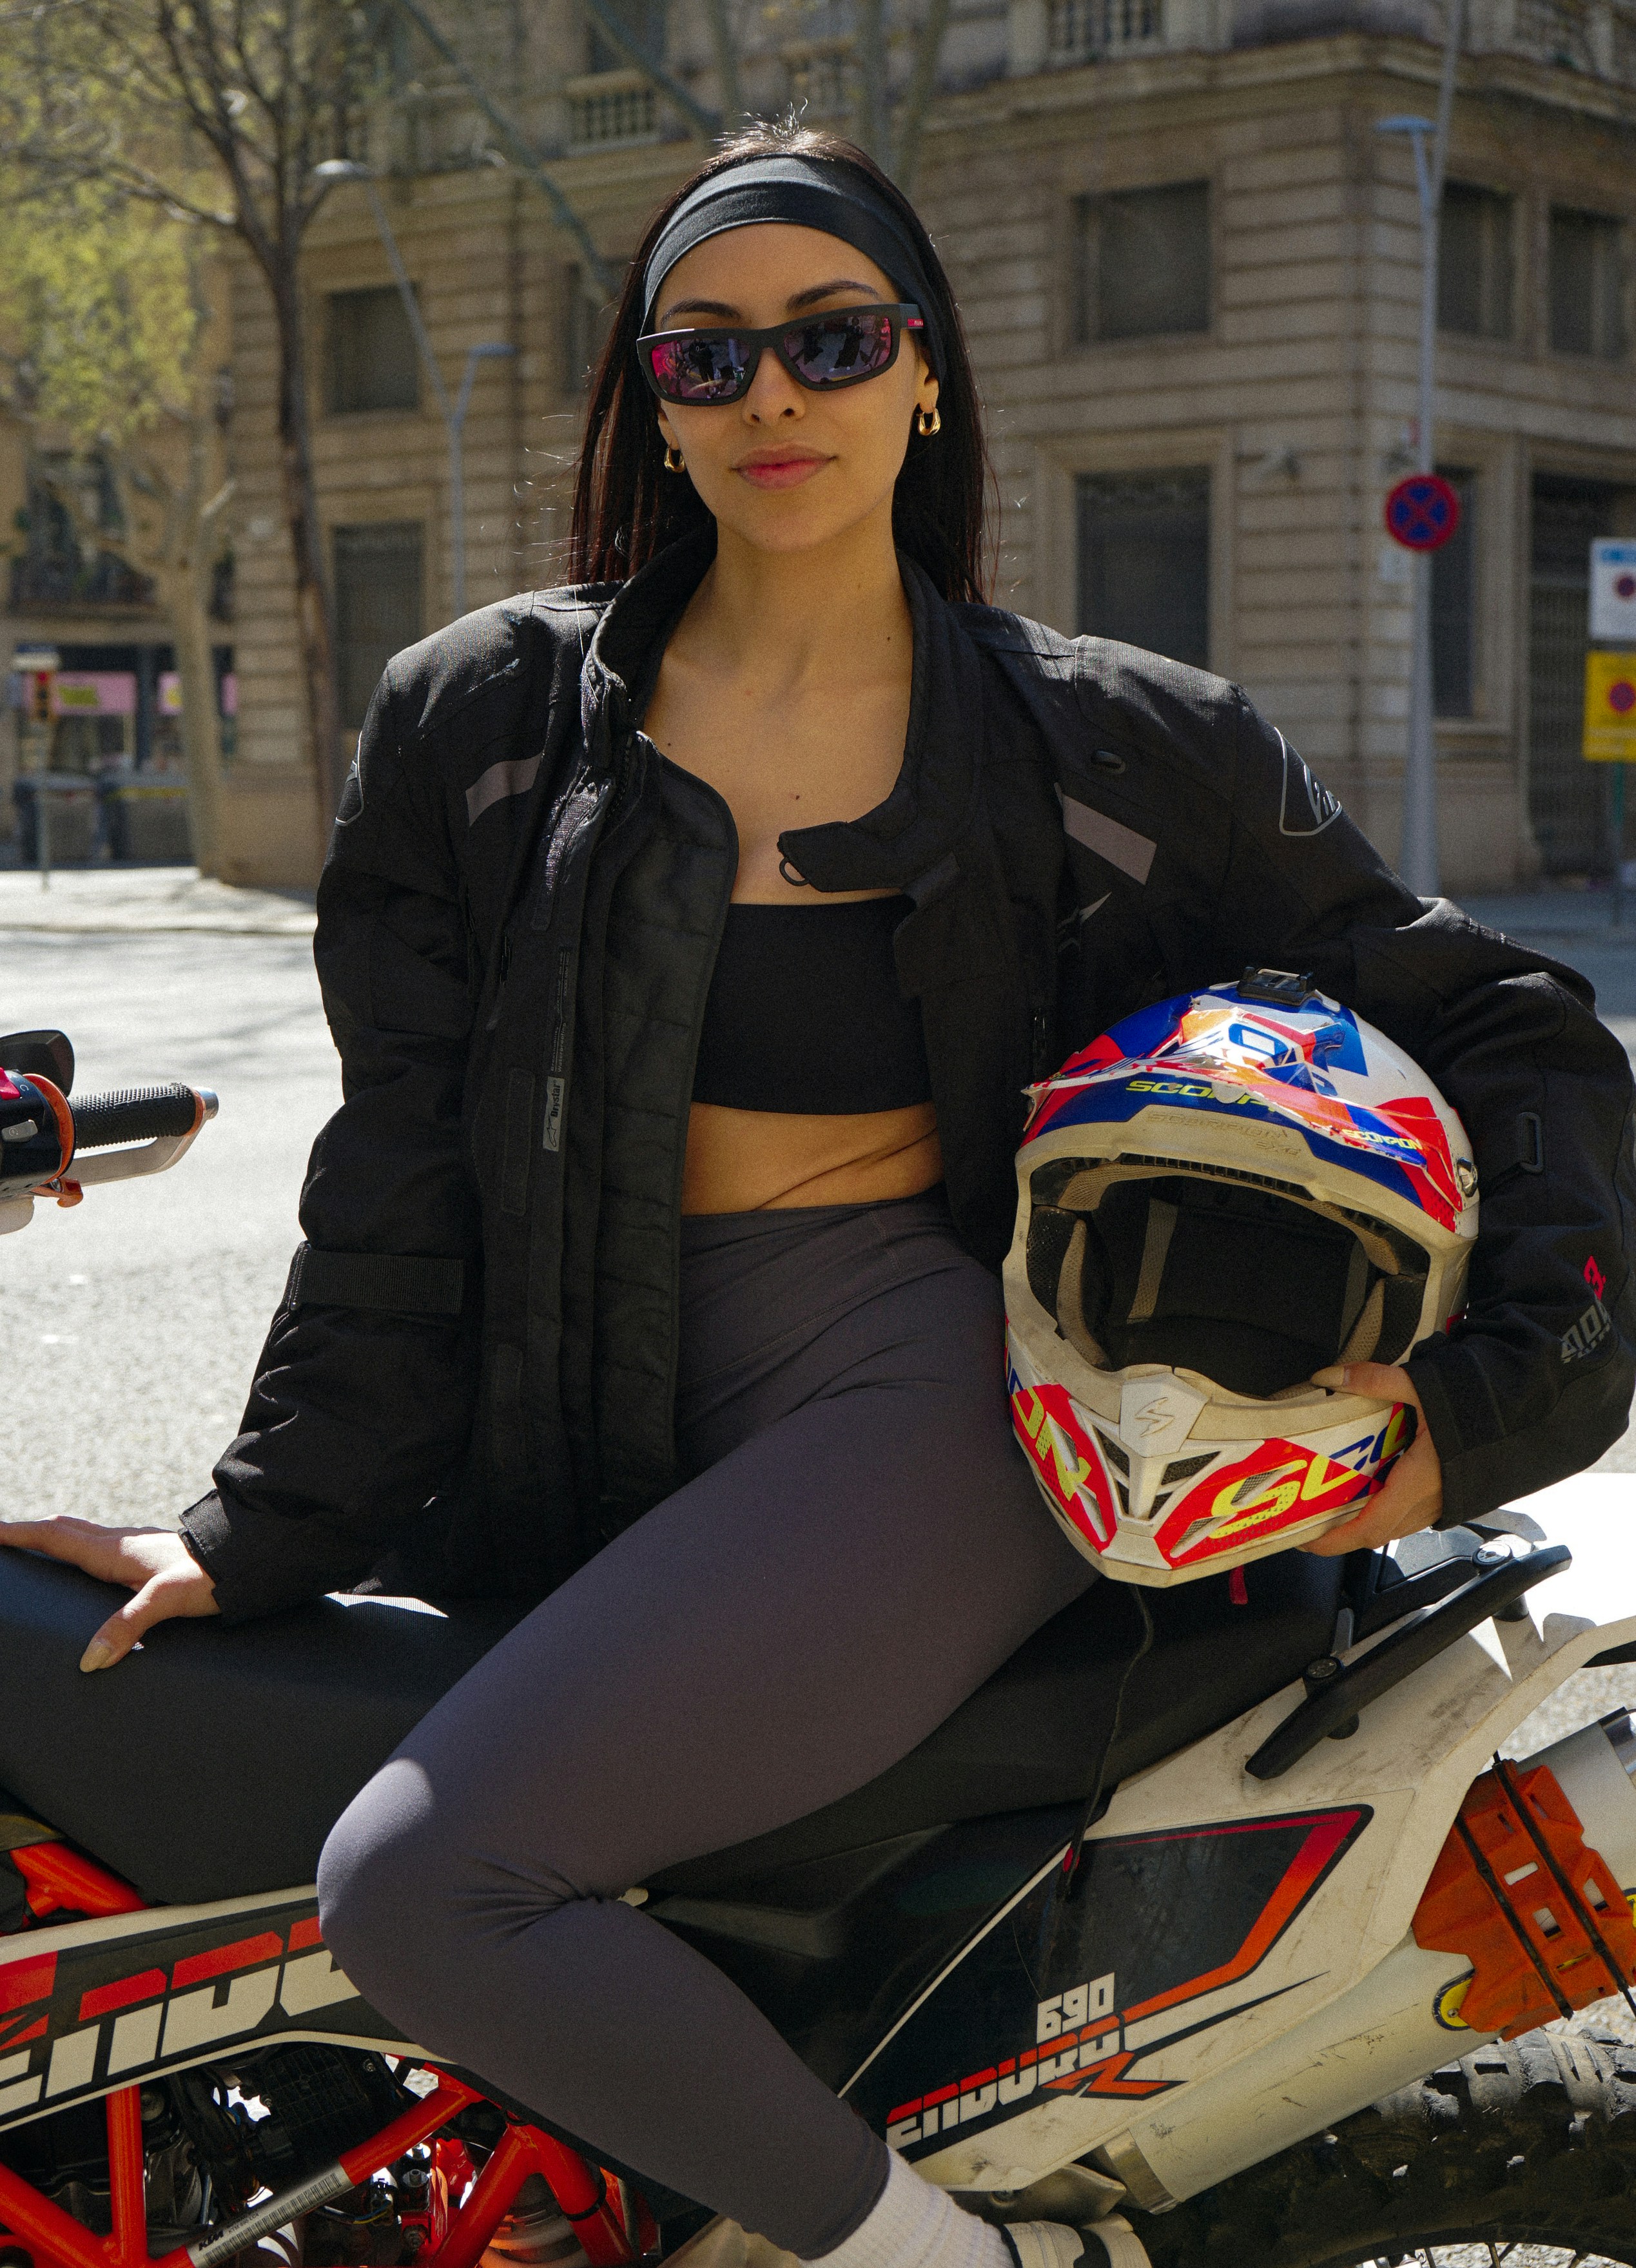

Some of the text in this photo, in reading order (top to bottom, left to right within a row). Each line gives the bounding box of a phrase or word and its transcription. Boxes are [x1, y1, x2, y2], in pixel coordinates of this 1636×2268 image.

[550, 1082, 561, 1118] Drystar
[1341, 1129, 1423, 1150] SCORPION
[1036, 1972, 1115, 2044] 690
[199, 2230, 224, 2251] KTM
